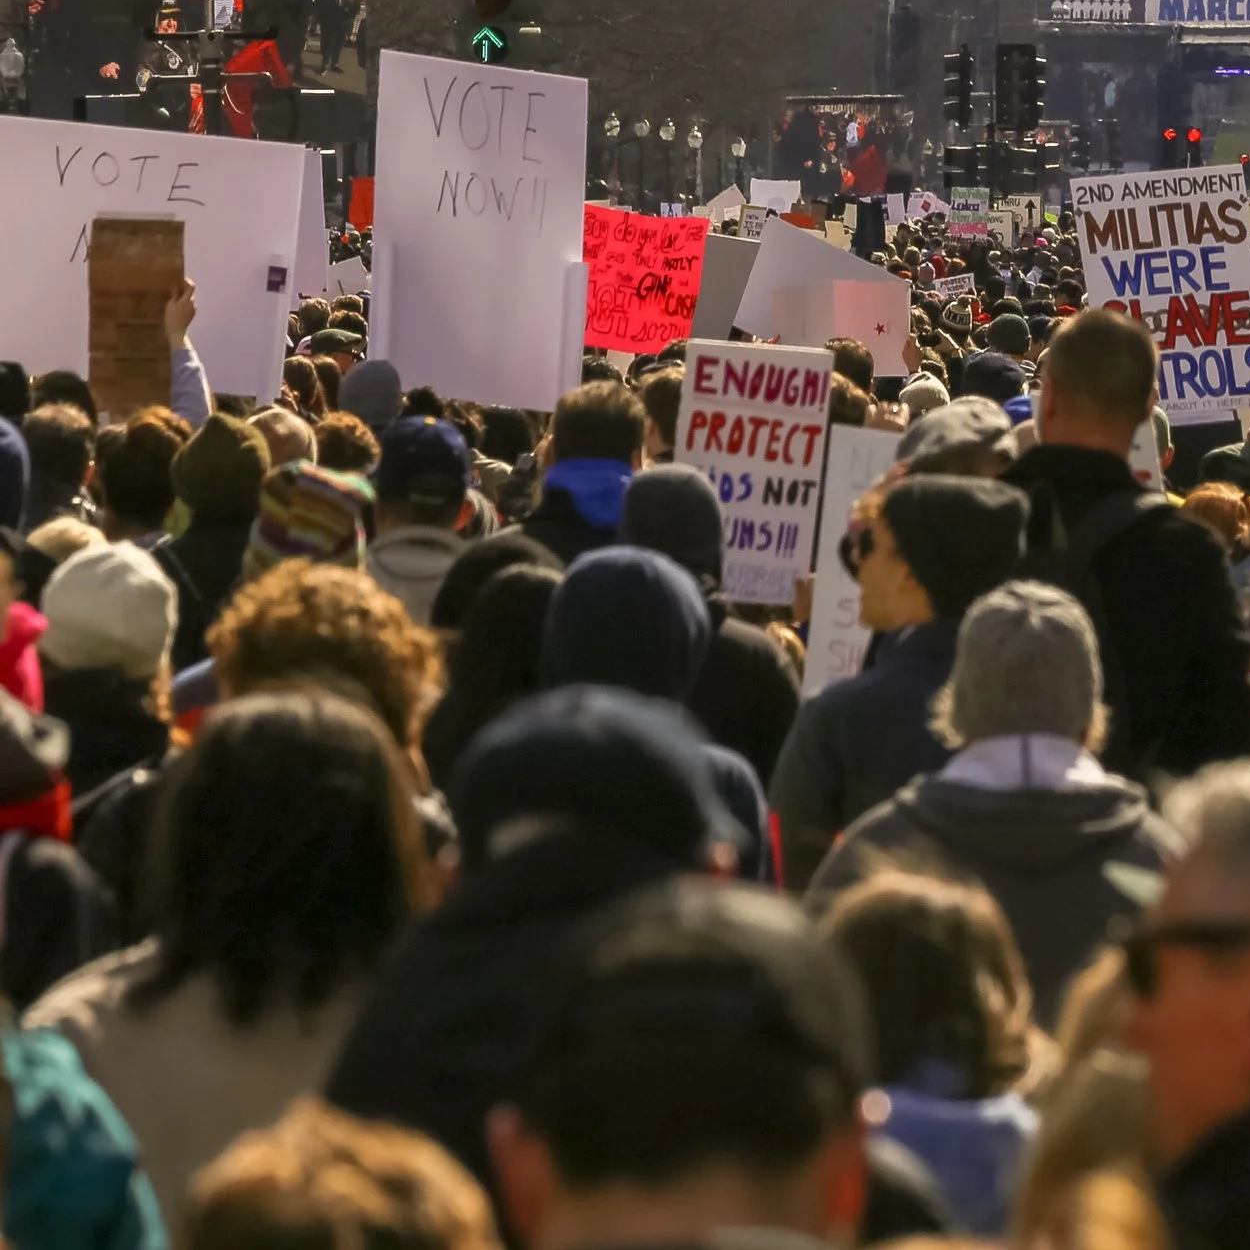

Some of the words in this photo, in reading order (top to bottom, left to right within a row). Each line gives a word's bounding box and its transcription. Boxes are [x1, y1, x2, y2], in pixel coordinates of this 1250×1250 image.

[423, 76, 546, 164] VOTE
[56, 146, 206, 206] VOTE
[1076, 183, 1114, 205] 2ND
[1121, 173, 1243, 201] AMENDMENT
[1101, 246, 1230, 296] WERE
[693, 354, 830, 413] ENOUGH!
[686, 408, 823, 467] PROTECT
[762, 477, 817, 507] NOT
[725, 516, 799, 560] UNS!!!
